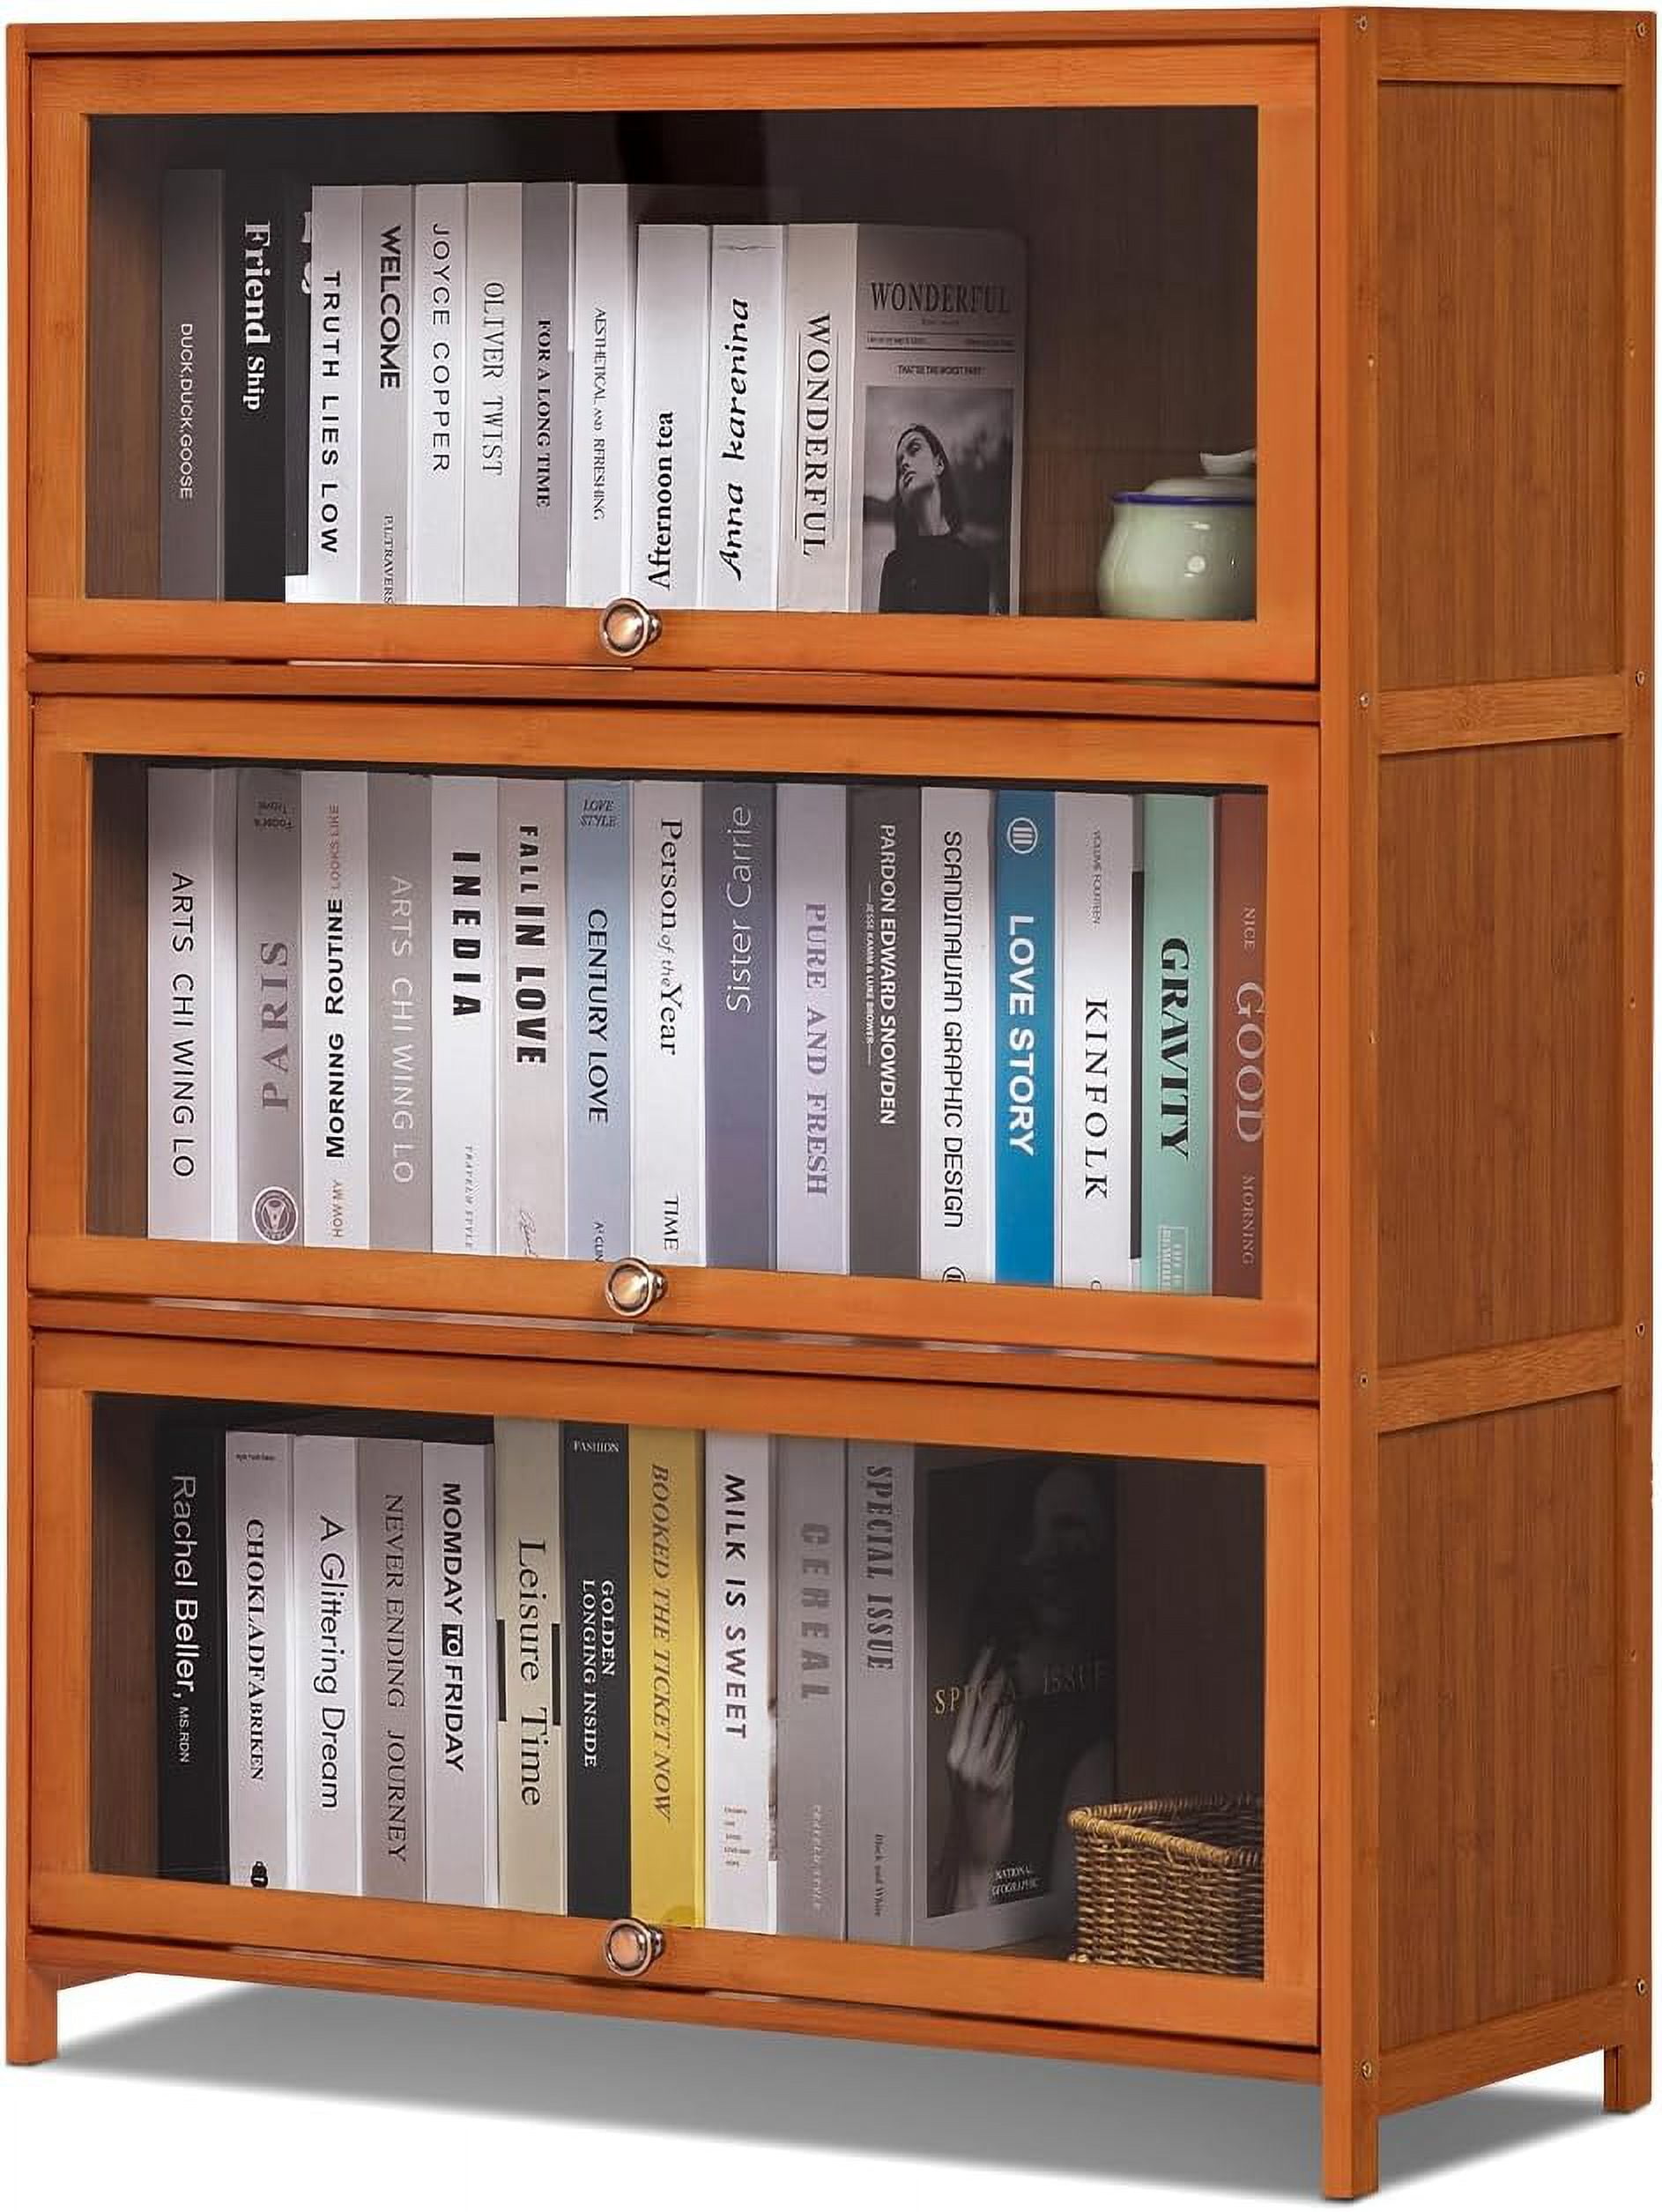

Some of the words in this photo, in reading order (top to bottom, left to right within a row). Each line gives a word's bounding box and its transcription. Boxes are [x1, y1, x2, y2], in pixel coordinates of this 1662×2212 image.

[244, 219, 271, 346] Friend
[380, 225, 402, 390] WELCOME
[433, 223, 450, 326] JOYCE
[870, 281, 1012, 314] WONDERFUL
[322, 271, 340, 378] TRUTH
[483, 282, 505, 379] OLIVER
[538, 319, 551, 366] FOR
[594, 307, 607, 406] AESTHETICAL
[243, 355, 265, 411] Ship
[433, 342, 450, 472] COPPER
[537, 367, 550, 386] A
[537, 390, 550, 447] LONG
[722, 297, 749, 461] karenina
[322, 395, 339, 466] LIES
[481, 396, 503, 476] TWIST
[658, 411, 674, 449] tea
[803, 314, 831, 557] WONDERFUL
[321, 483, 338, 553] LOW
[536, 451, 550, 508] TIME
[648, 455, 672, 590] Afternoon
[719, 481, 743, 582] Anna
[330, 803, 340, 840] LIKE
[580, 814, 616, 828] STYLE
[582, 799, 614, 812] LOVE
[330, 842, 340, 892] LOOKS
[518, 825, 539, 894] FALL
[660, 818, 684, 929] Person
[725, 805, 752, 909] Carrie
[880, 824, 897, 915] PARDON
[171, 872, 194, 954] ARTS
[325, 898, 344, 1015] ROUTINE
[390, 875, 414, 959] ARTS
[515, 905, 547, 946] IN
[659, 932, 671, 955] of
[805, 902, 827, 990] PURE
[943, 831, 963, 1013] SCANDINAVIAN
[1243, 906, 1256, 948] NICE
[171, 973, 194, 1028] CHI
[390, 976, 414, 1032] CHI
[587, 909, 608, 1043] CENTURY
[660, 960, 671, 985] the
[725, 917, 752, 1013] Sister
[880, 919, 897, 1011] EDWARD
[1009, 915, 1035, 1016] LOVE
[260, 941, 289, 1114] PARIS
[516, 966, 547, 1065] LOVE
[660, 984, 684, 1057] Year
[805, 1007, 827, 1076] AND
[1160, 937, 1191, 1161] GRAVITY
[172, 1040, 195, 1126] WING
[325, 1032, 345, 1160] MORNING
[391, 1044, 414, 1132] WING
[588, 1052, 609, 1125] LOVE
[880, 1015, 897, 1125] SNOWDEN
[943, 1023, 963, 1129] GRAPHIC
[1009, 1027, 1035, 1156] STORY
[1085, 998, 1109, 1200] KINFOLK
[1235, 981, 1265, 1144] GOOD
[173, 1137, 195, 1178] LO
[392, 1140, 414, 1184] LO
[806, 1092, 827, 1196] FRESH
[943, 1137, 963, 1228] DESIGN
[331, 1179, 342, 1202] MY
[331, 1204, 342, 1238] HOW
[663, 1195, 680, 1252] TIME
[1241, 1175, 1256, 1266] MORNING
[573, 1441, 620, 1453] FASHION
[172, 1475, 198, 1588] Rachel
[320, 1514, 345, 1540] A
[384, 1495, 404, 1588] NEVER
[442, 1482, 463, 1615] MOMDAY
[651, 1464, 670, 1579] BOOKED
[724, 1473, 746, 1561] MILK
[867, 1466, 894, 1579] SPECIAL
[313, 1553, 348, 1696] Glittering
[444, 1624, 463, 1655] TO
[518, 1537, 547, 1681] Leisure
[582, 1579, 597, 1684] LONGING
[601, 1579, 615, 1676] GOLDEN
[652, 1589, 670, 1643] THE
[724, 1580, 746, 1608] IS
[800, 1523, 831, 1700] CEREAL
[867, 1593, 894, 1672] ISSUE
[174, 1598, 200, 1699] Beller,
[245, 1518, 265, 1782] CHOKLADFABRIKEN
[386, 1601, 405, 1708] ENDING
[724, 1627, 747, 1740] SWEET
[444, 1665, 464, 1773] FRIDAY
[583, 1692, 597, 1767] INSIDE
[652, 1649, 671, 1749] TICKET
[321, 1708, 346, 1809] Dream
[386, 1729, 406, 1862] JOURNEY
[521, 1707, 550, 1807] Time
[653, 1756, 671, 1822] NOW
